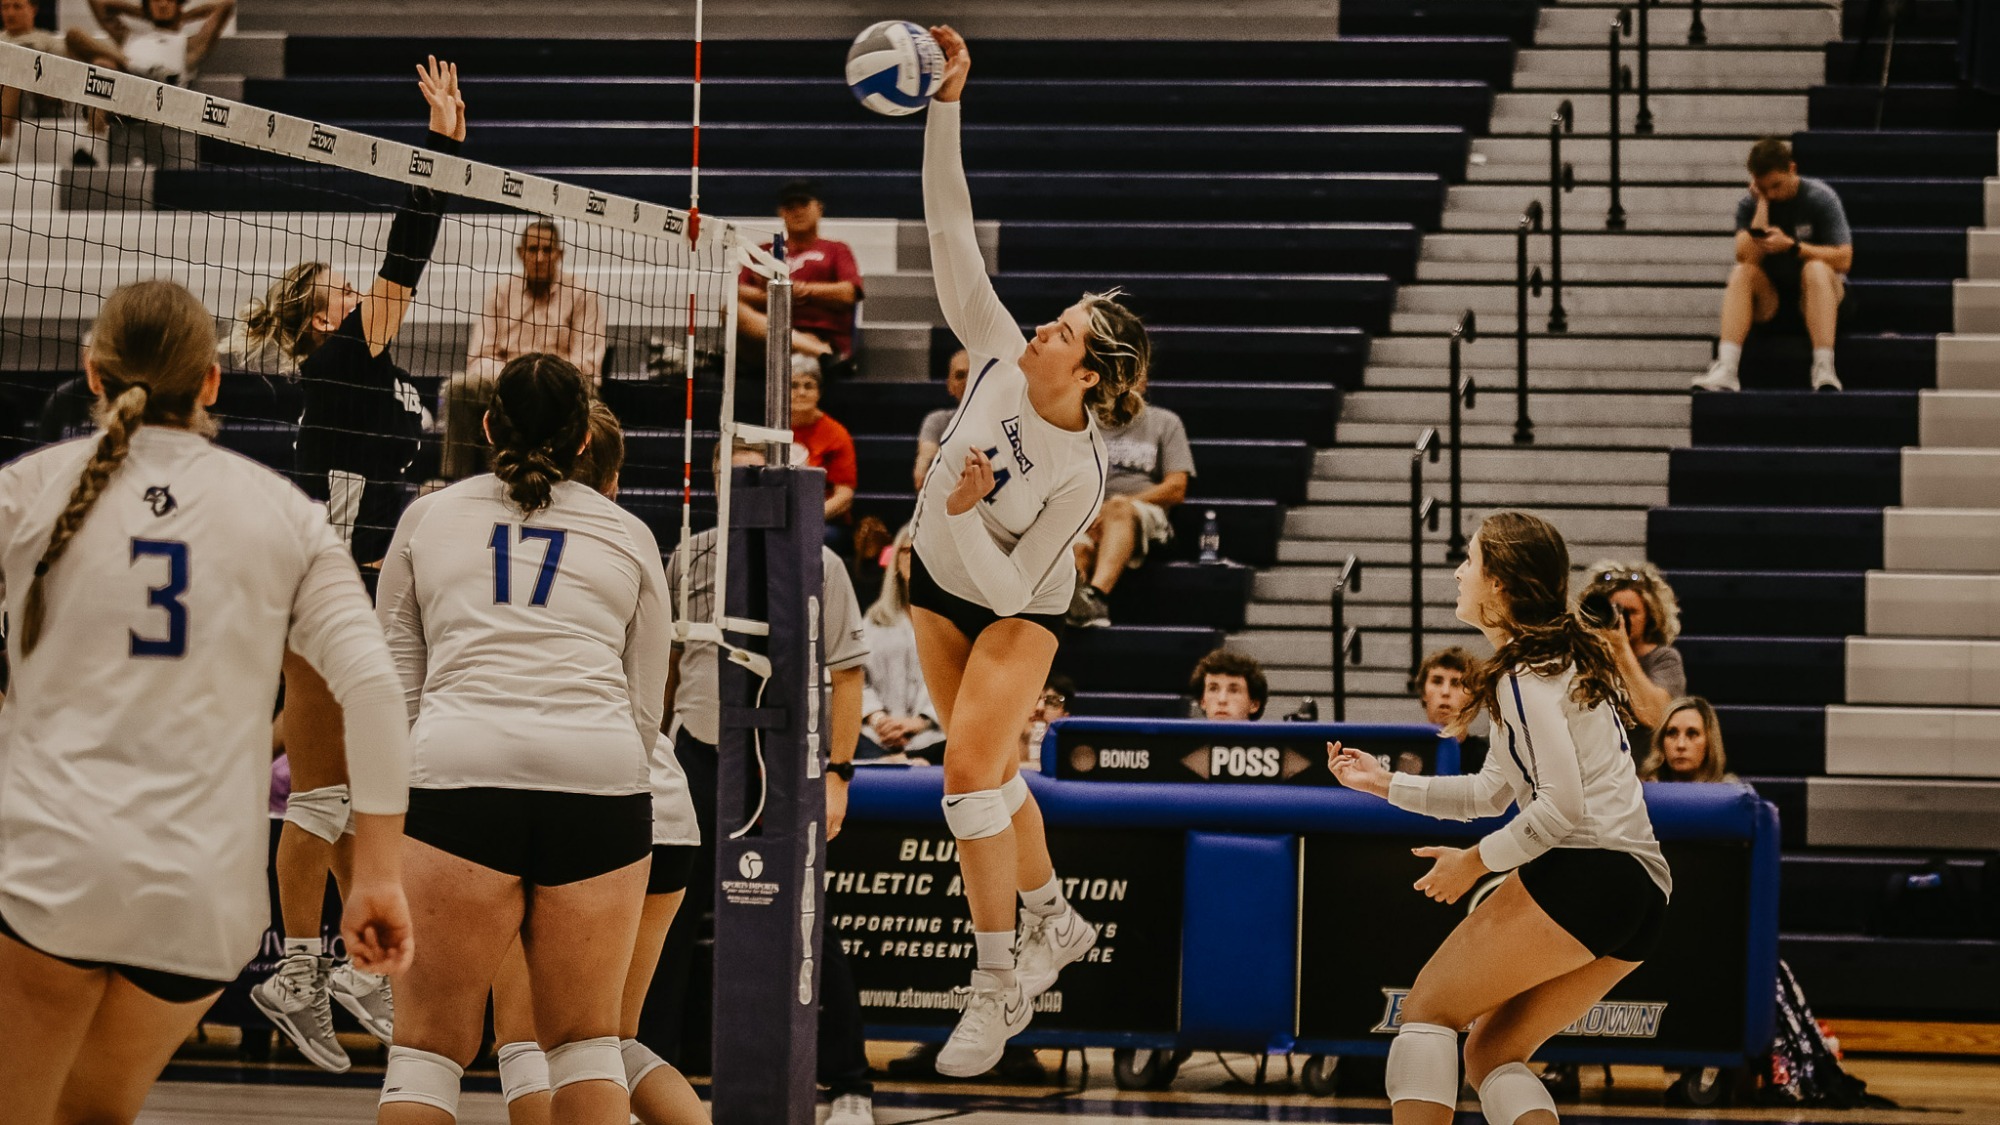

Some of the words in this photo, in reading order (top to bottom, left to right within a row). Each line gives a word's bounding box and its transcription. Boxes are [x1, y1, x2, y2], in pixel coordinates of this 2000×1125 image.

[488, 523, 568, 607] 17
[128, 537, 189, 658] 3
[1100, 749, 1150, 769] BONUS
[1211, 746, 1280, 777] POSS
[900, 839, 959, 862] BLU
[823, 871, 933, 895] THLETIC
[881, 940, 973, 959] PRESENT
